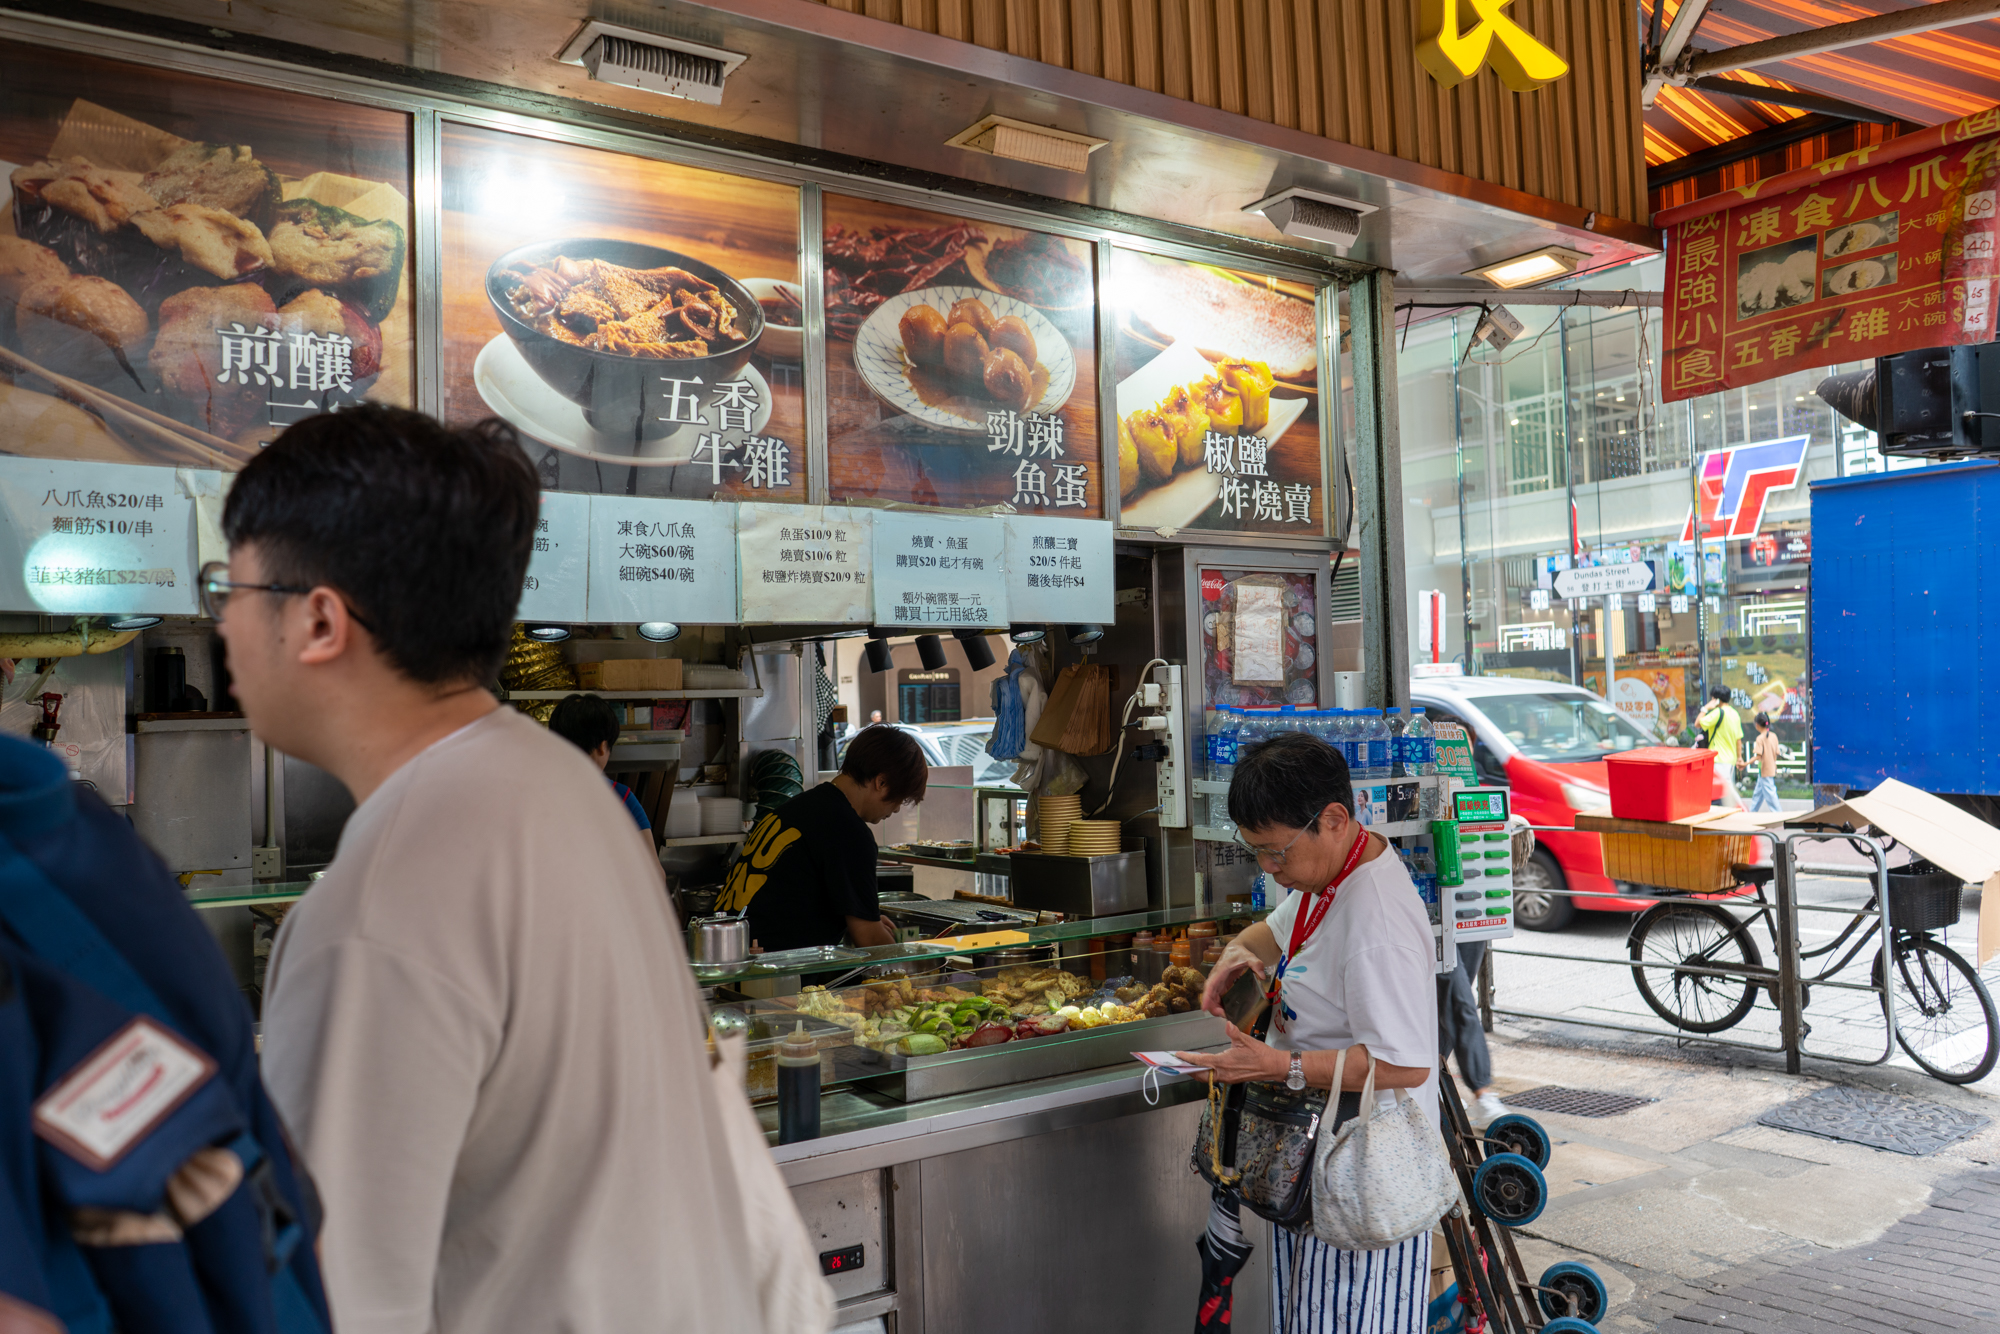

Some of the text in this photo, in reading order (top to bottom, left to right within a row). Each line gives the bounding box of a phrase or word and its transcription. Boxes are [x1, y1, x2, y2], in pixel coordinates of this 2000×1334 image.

[1900, 210, 1947, 234] 大碗
[1899, 248, 1944, 271] 小碗
[1898, 290, 1946, 313] 大碗
[1898, 311, 1948, 332] 小碗
[1731, 306, 1890, 370] 五香牛雜
[216, 322, 354, 394] 煎釀
[657, 375, 761, 433] 五香
[985, 408, 1066, 461] 勁辣
[690, 431, 792, 489] 牛雜
[1202, 429, 1270, 477] 椒鹽
[1011, 458, 1089, 509] 魚蛋
[41, 488, 164, 512] 八爪魚$20/串
[1217, 476, 1314, 525] 炸燒賣
[52, 515, 154, 538] 麵筋$10/串
[616, 519, 696, 539] 凍食八爪魚
[779, 526, 847, 542] 魚蛋$10/9 粒
[618, 542, 695, 561] 大碗$60/碗
[911, 534, 969, 550] 燒賣、魚蛋
[1032, 535, 1079, 551] 煎釀三寶
[780, 548, 848, 563] 燒賣$10/6 粒
[1029, 555, 1082, 570] $20/5 件起
[619, 565, 695, 583] 細碗$40/碗
[853, 571, 866, 585] 粒
[1027, 573, 1085, 589] 隨後每件$4
[1573, 567, 1630, 580] Dundas Street
[902, 591, 982, 606] 額外碗需要一元
[894, 605, 989, 623] 購買十元用紙袋
[1436, 746, 1457, 766] 30
